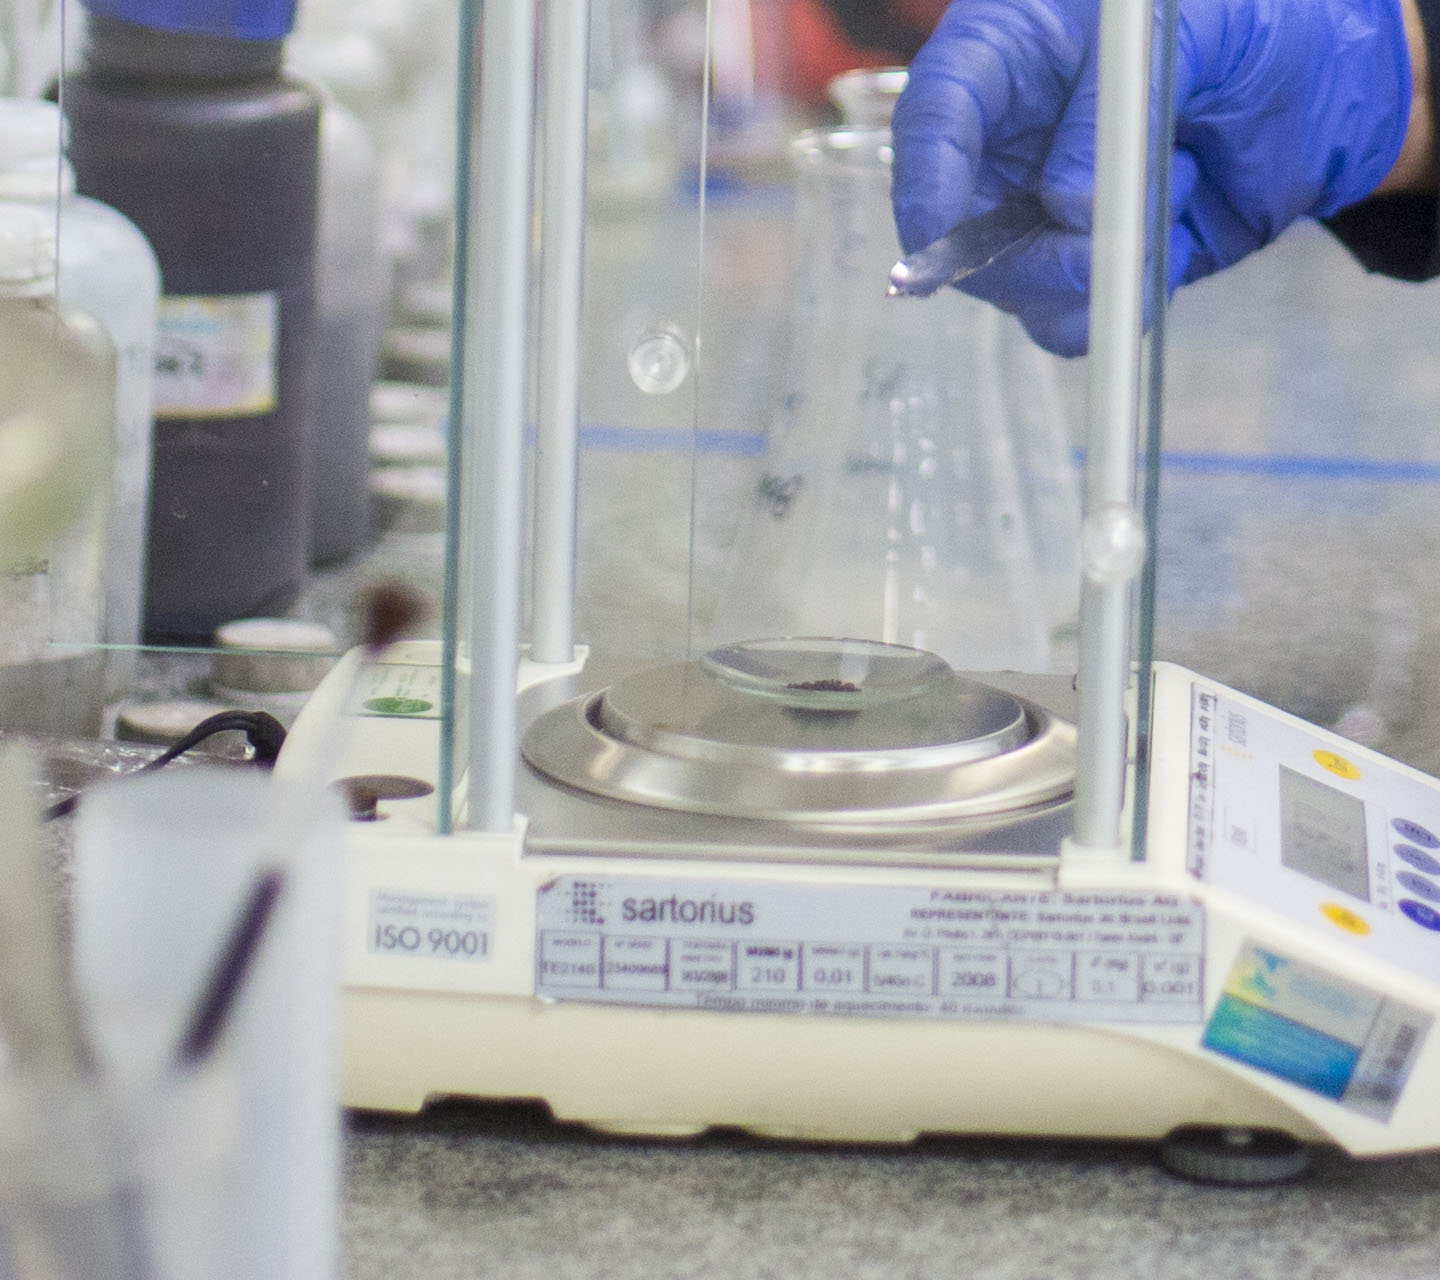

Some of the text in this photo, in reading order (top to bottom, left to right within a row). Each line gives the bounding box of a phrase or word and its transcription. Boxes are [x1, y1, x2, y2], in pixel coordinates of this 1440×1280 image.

[622, 893, 755, 925] sartorius
[375, 924, 488, 955] ISO 9001
[751, 966, 786, 984] 210
